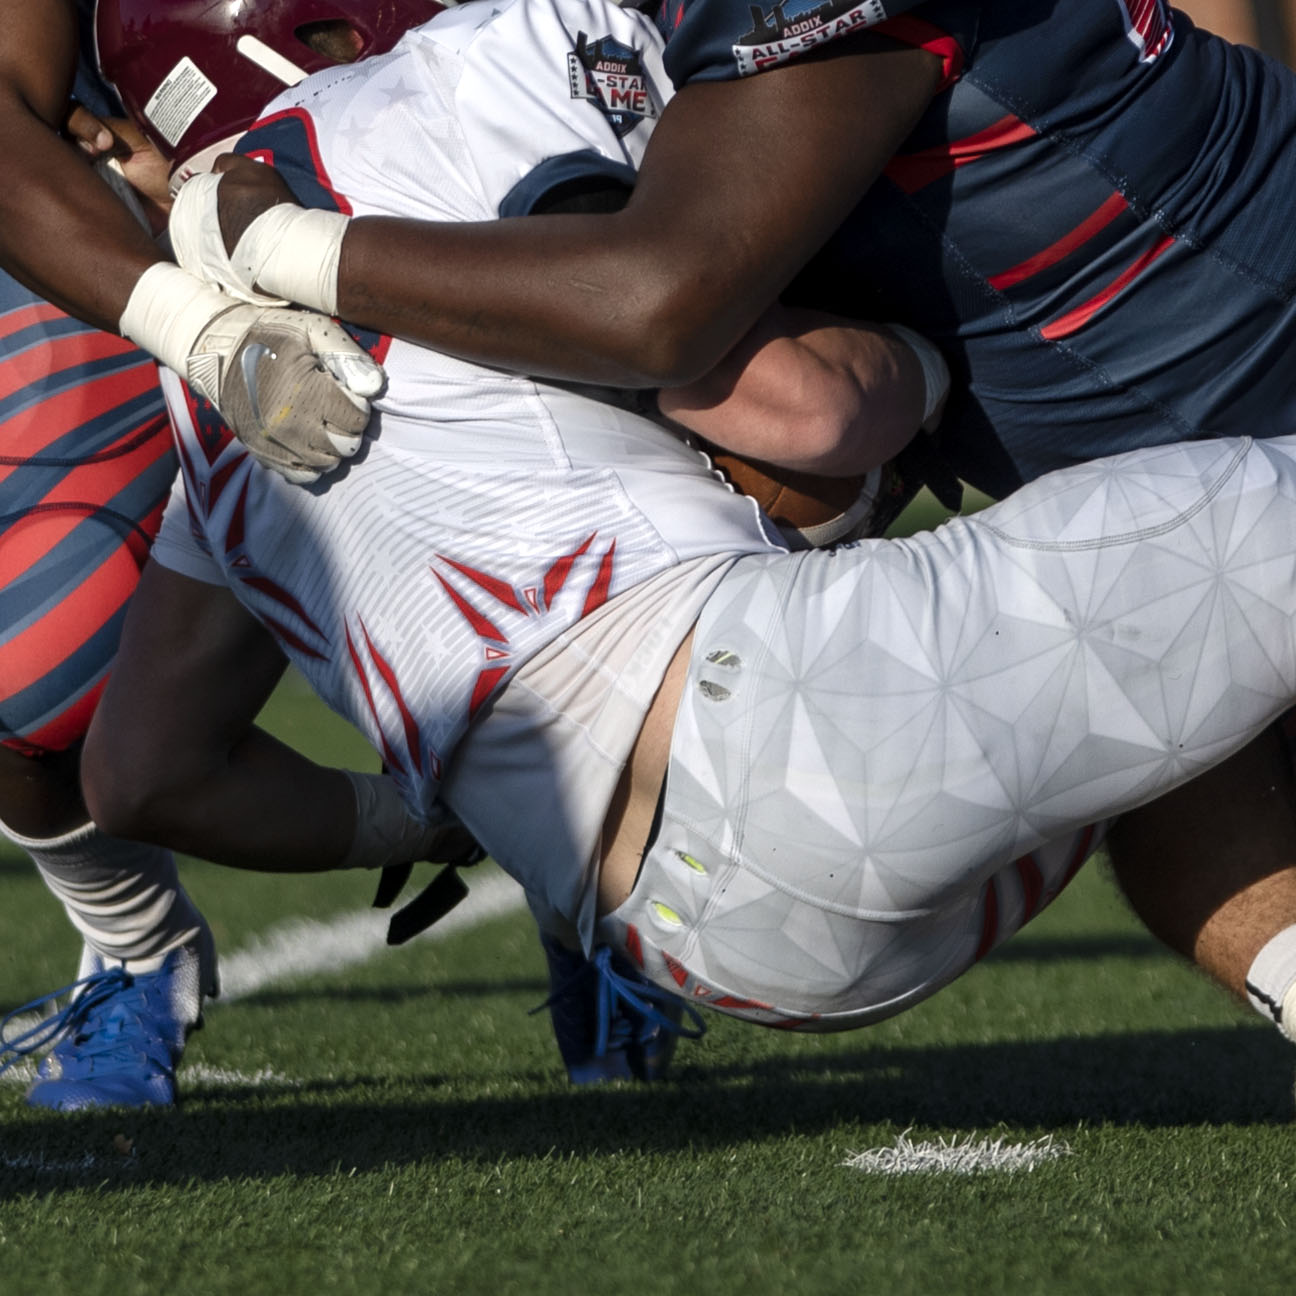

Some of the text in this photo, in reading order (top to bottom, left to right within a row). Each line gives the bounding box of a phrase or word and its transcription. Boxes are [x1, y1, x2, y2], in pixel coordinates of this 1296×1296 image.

[752, 8, 866, 60] ALL-STAR
[783, 15, 825, 39] ADDIX
[595, 60, 627, 73] ADDIX
